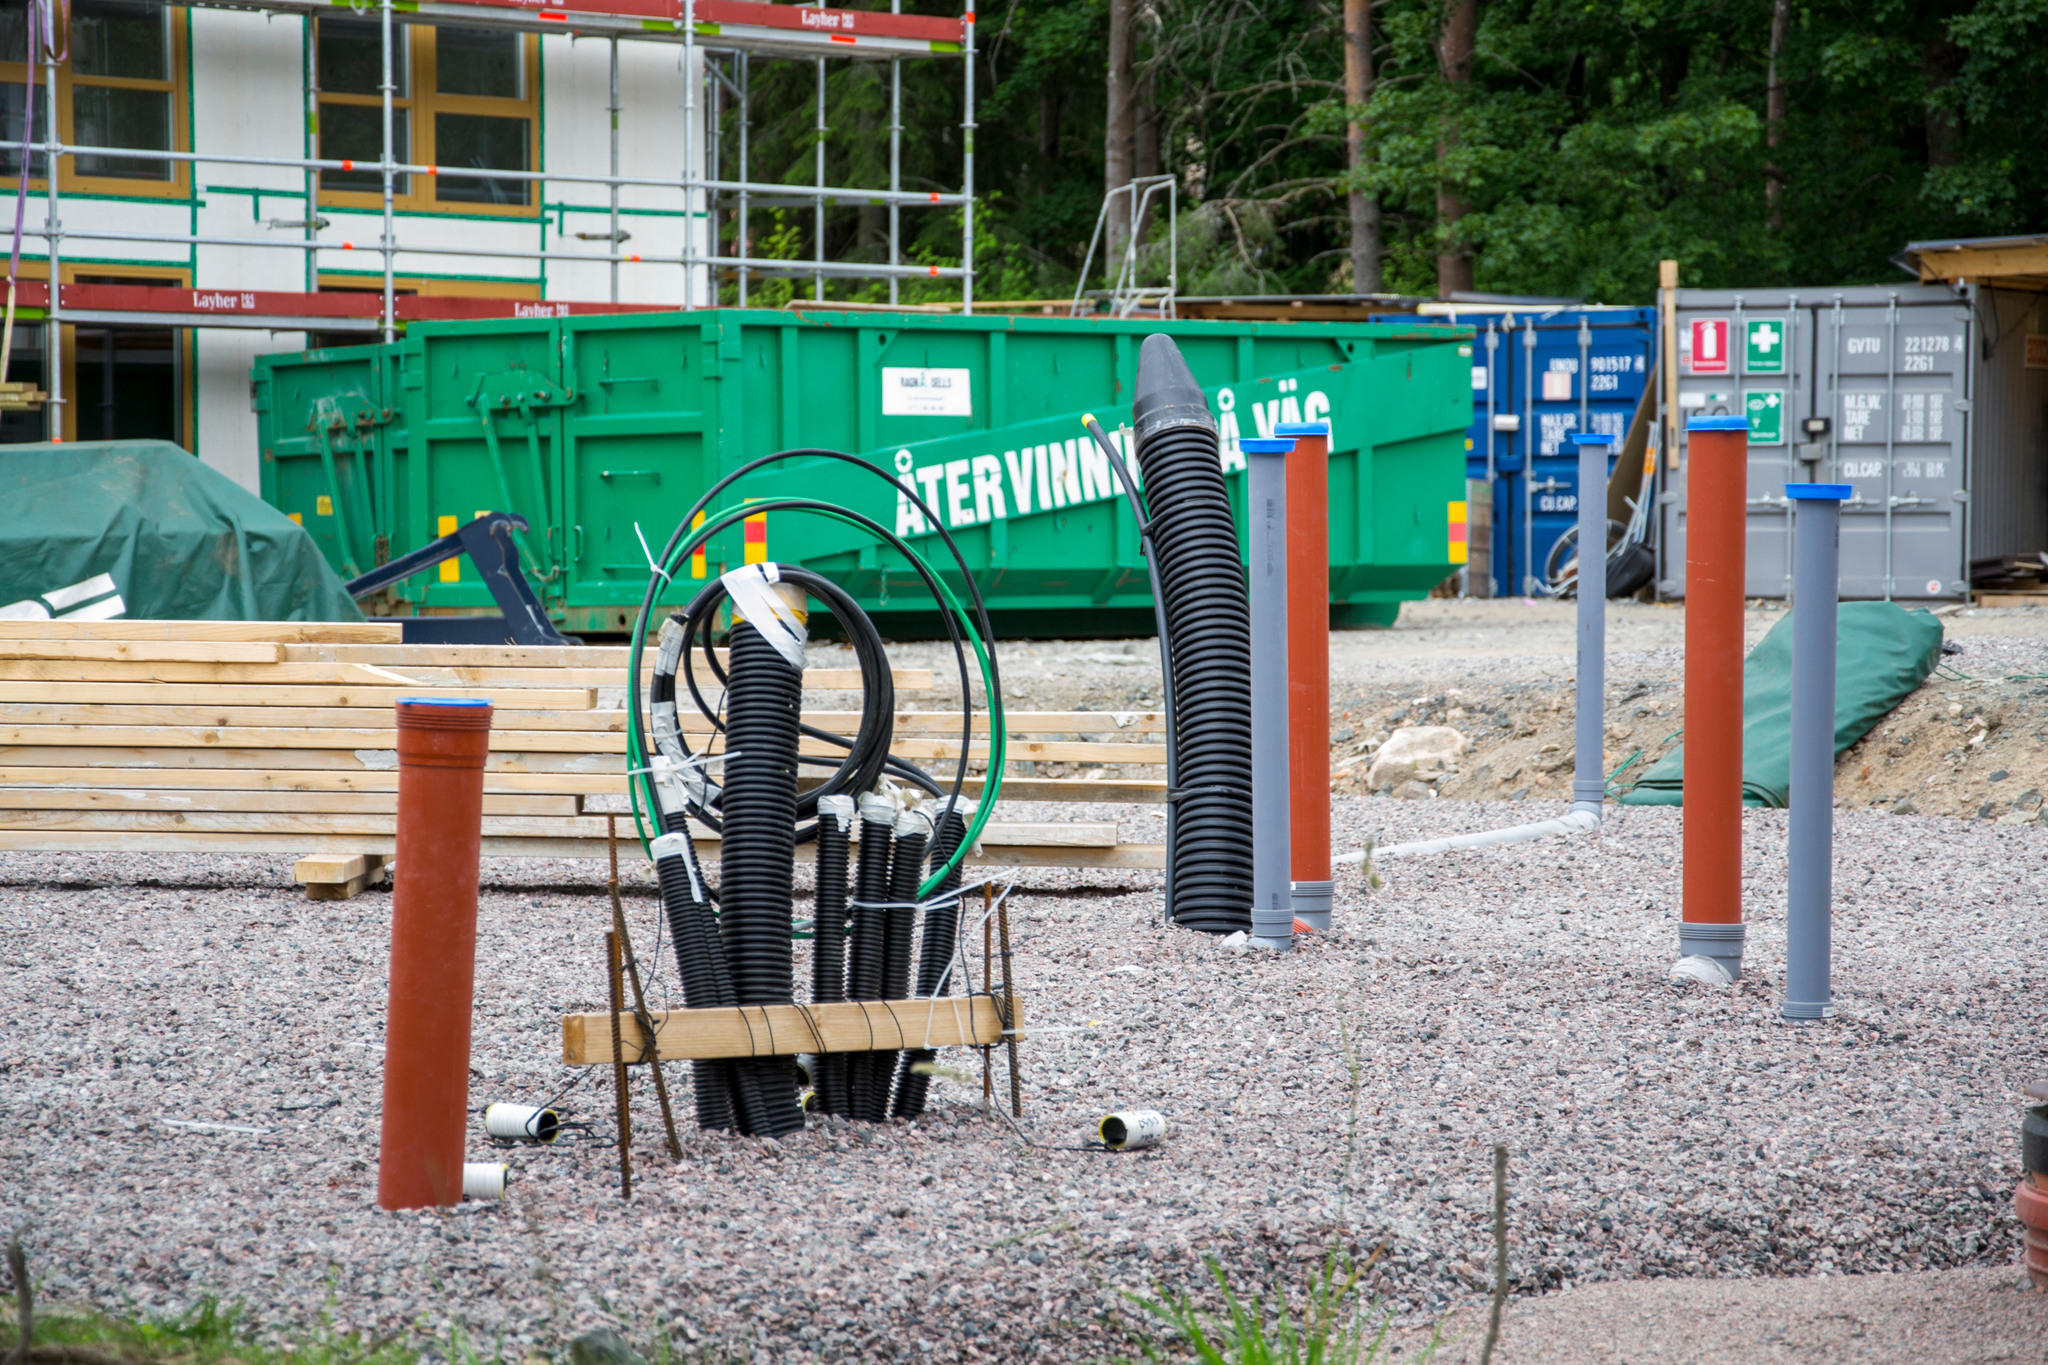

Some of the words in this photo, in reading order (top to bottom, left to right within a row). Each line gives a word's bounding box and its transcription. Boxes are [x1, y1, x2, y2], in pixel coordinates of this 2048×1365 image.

[802, 9, 840, 28] Layher
[193, 291, 238, 311] Layher
[514, 302, 553, 319] Layher
[1847, 337, 1881, 354] GVTU
[1904, 336, 1950, 353] 221278
[1590, 355, 1632, 373] 901517
[1904, 355, 1934, 371] 22G1
[1845, 410, 1870, 425] TARE
[1843, 425, 1864, 441] NET
[894, 427, 1143, 538] ÅTERVINNI
[1215, 387, 1248, 473] Å
